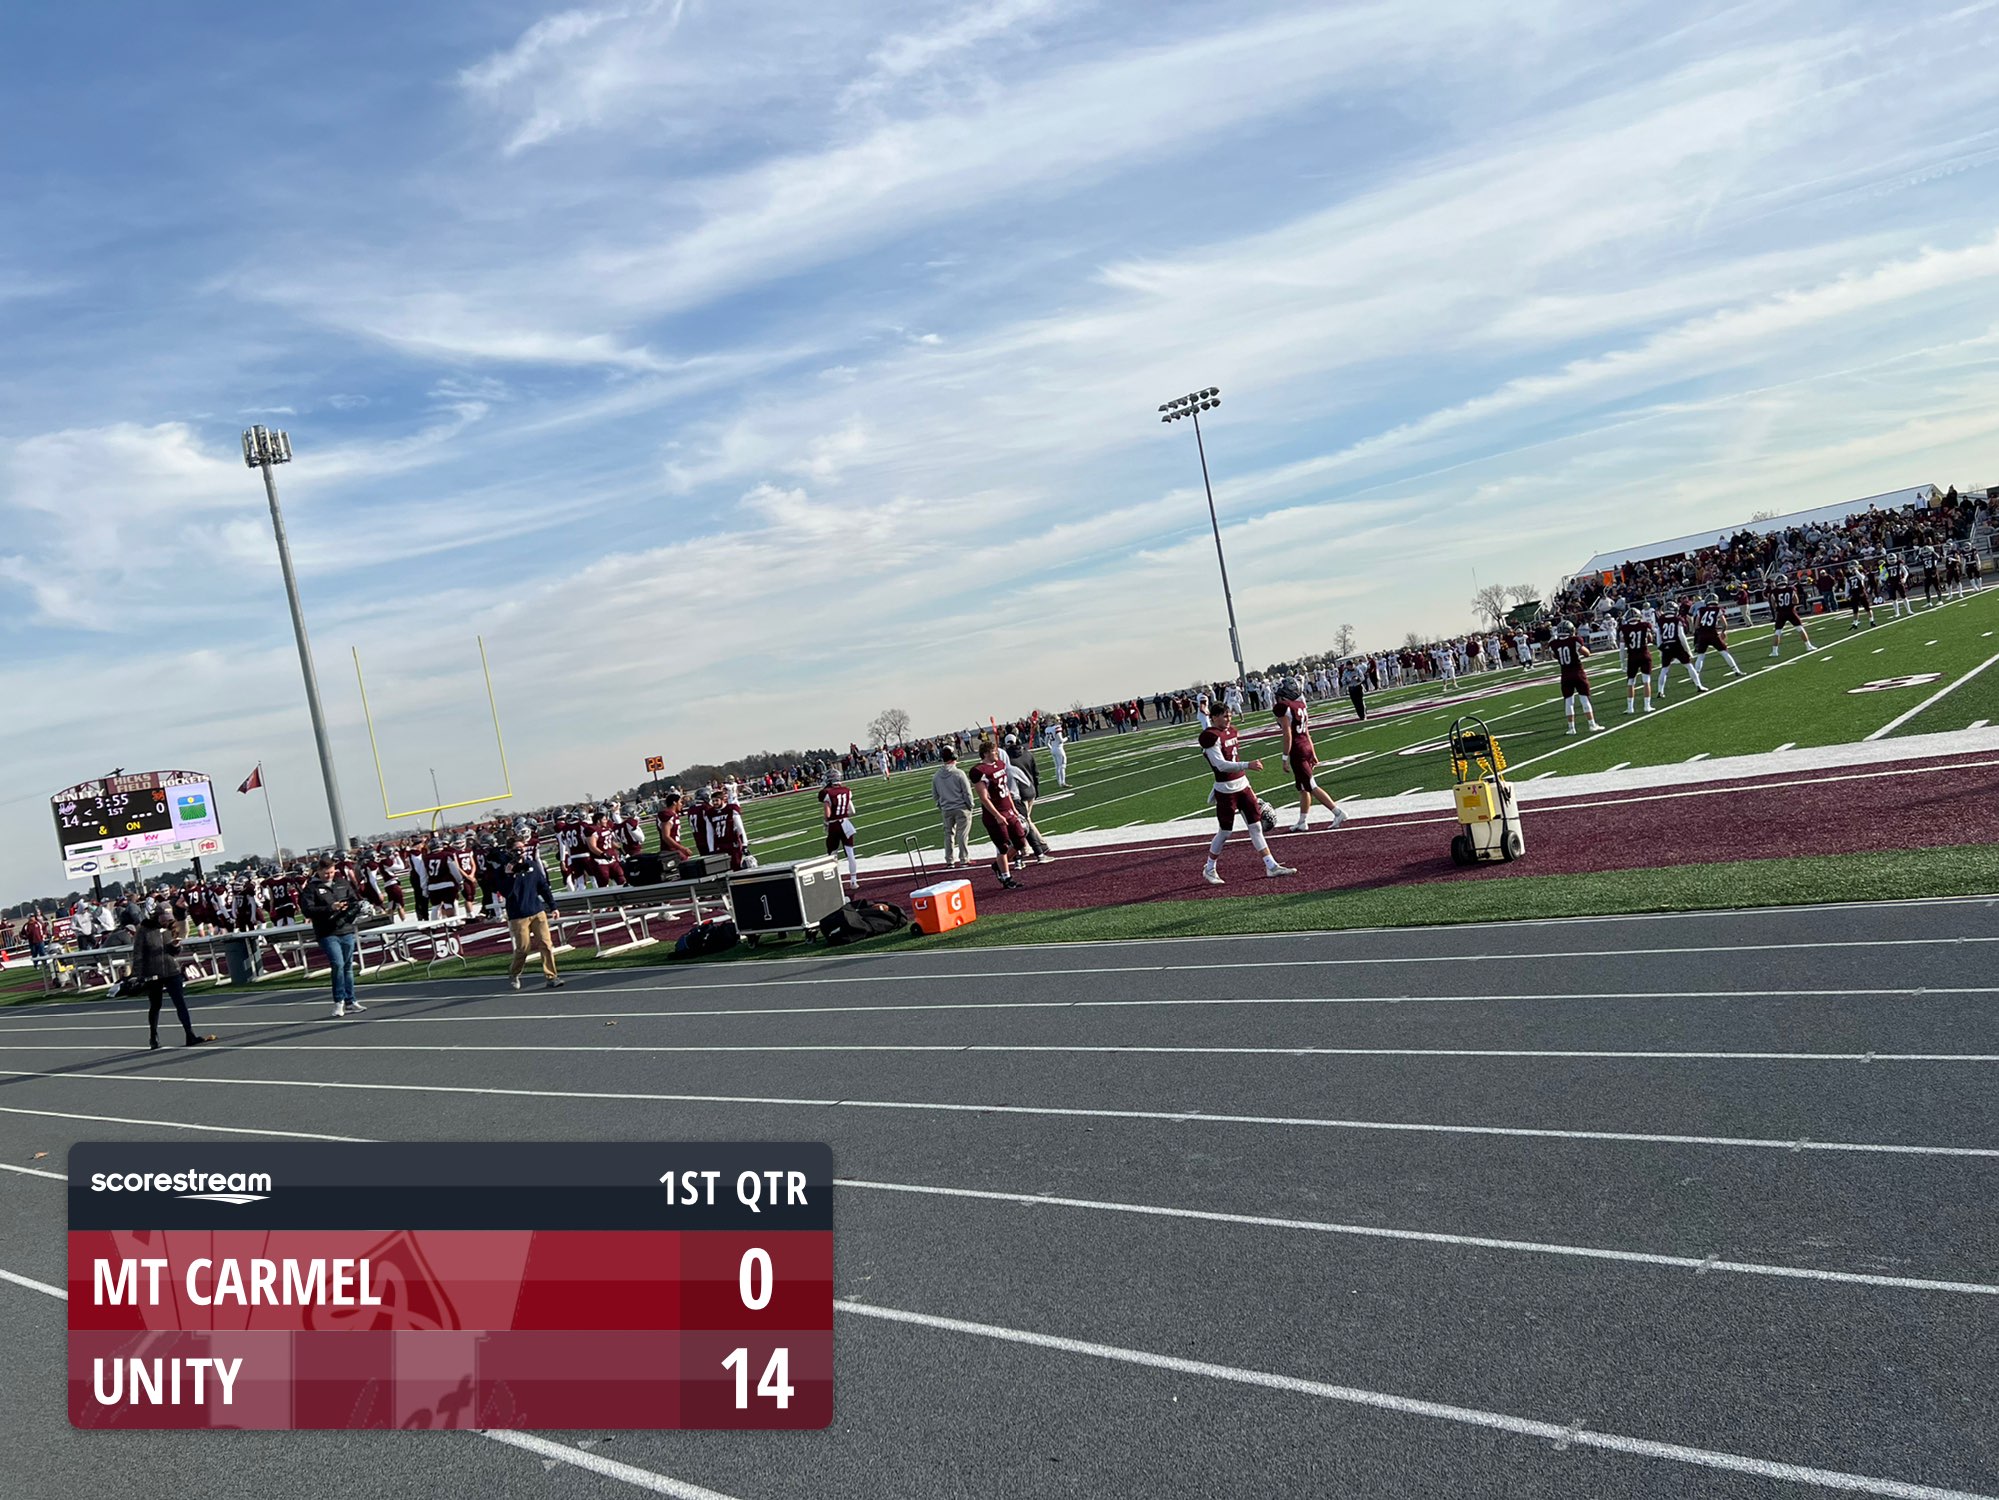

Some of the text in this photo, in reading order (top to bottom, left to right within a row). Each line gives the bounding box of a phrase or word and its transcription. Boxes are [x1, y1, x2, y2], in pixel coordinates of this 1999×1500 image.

[1778, 594, 1791, 607] 50
[1700, 610, 1716, 627] 45
[1662, 622, 1675, 639] 20
[1629, 631, 1642, 649] 31
[1557, 646, 1571, 665] 10
[648, 757, 664, 771] 25
[113, 774, 152, 786] HICKS
[159, 774, 210, 788] ROCKETS
[53, 788, 105, 803] UNITY
[116, 782, 152, 794] FIELD
[94, 793, 129, 809] 3:55
[156, 802, 165, 813] 0
[836, 793, 848, 816] 11
[107, 807, 124, 816] 1ST
[61, 815, 80, 828] 14
[125, 821, 141, 832] ON
[715, 821, 727, 838] 47
[428, 859, 441, 876] 57
[188, 891, 199, 904] 79
[272, 885, 285, 899] 33
[760, 894, 772, 920] 1
[951, 892, 962, 911] G
[435, 937, 460, 959] 50
[185, 964, 200, 979] 40
